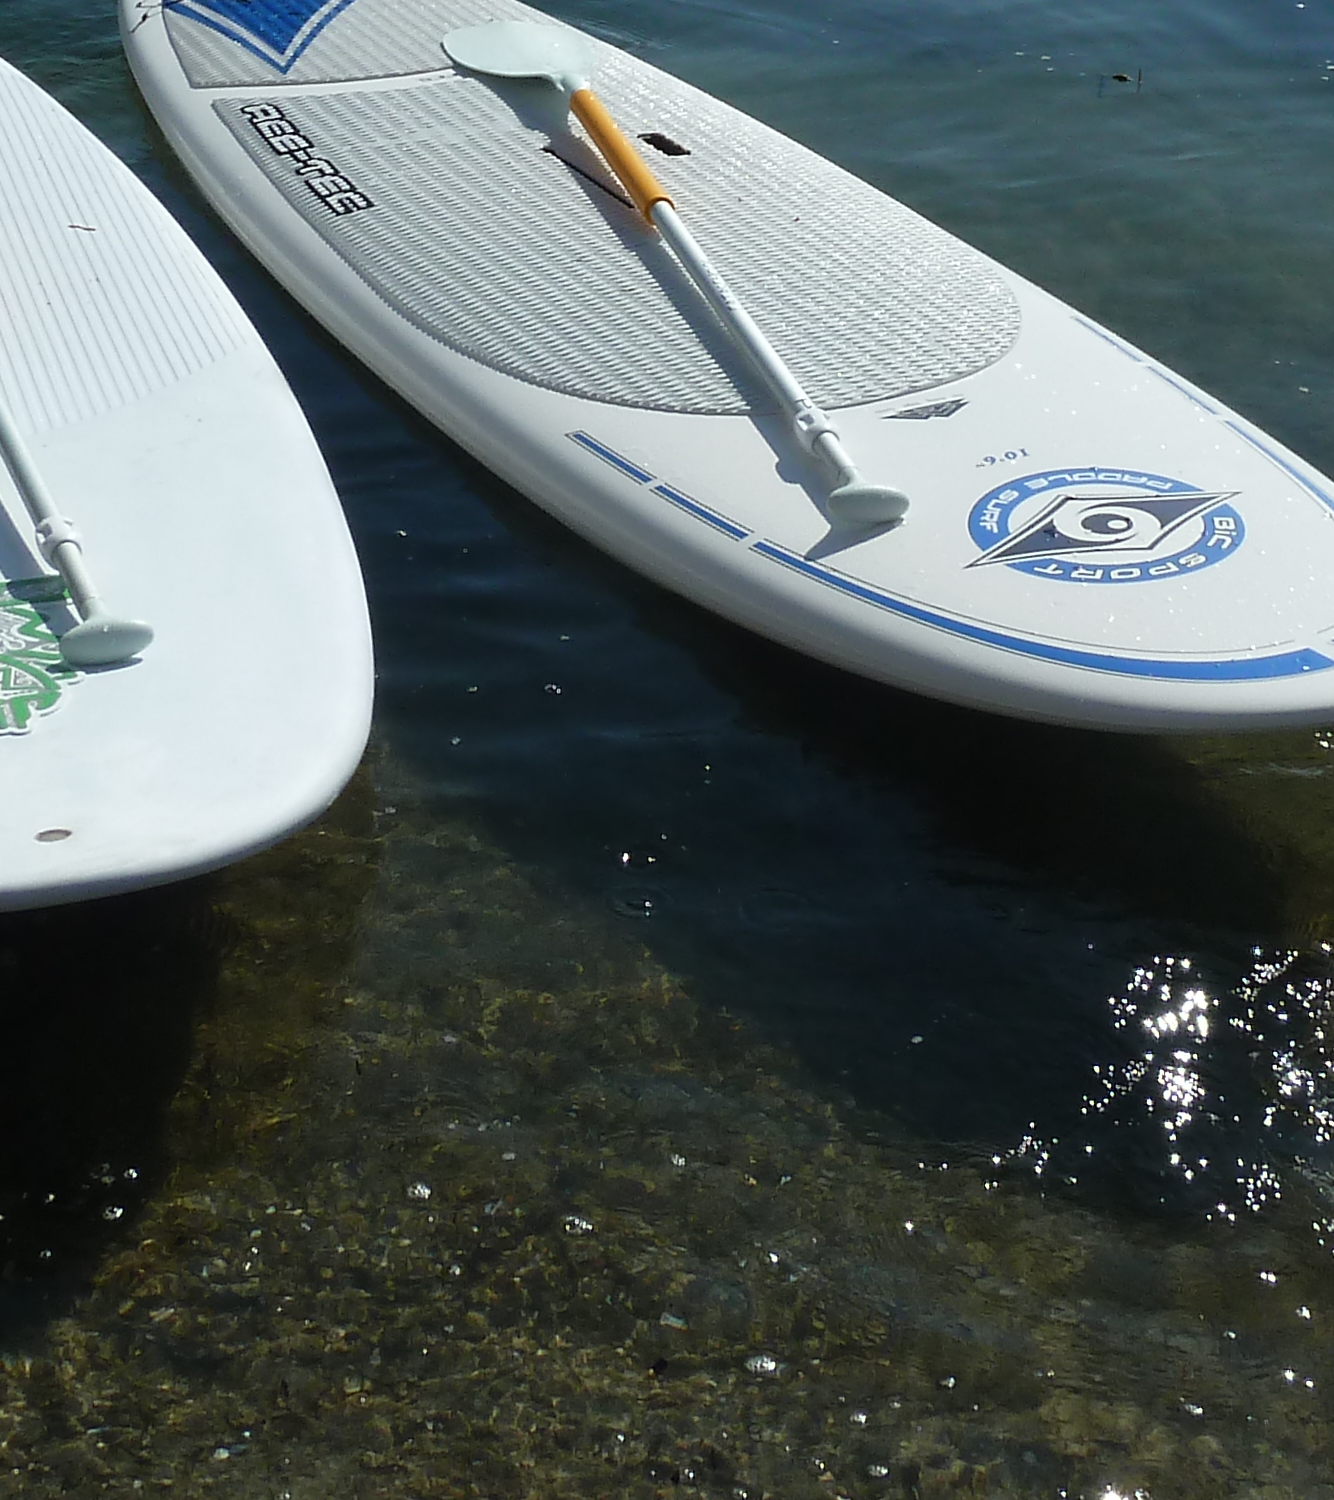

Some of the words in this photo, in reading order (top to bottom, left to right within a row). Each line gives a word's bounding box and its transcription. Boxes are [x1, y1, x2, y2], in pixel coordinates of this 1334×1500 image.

[1023, 471, 1172, 490] PADDLE
[978, 489, 1019, 534] SURF
[1033, 552, 1208, 580] SPORT
